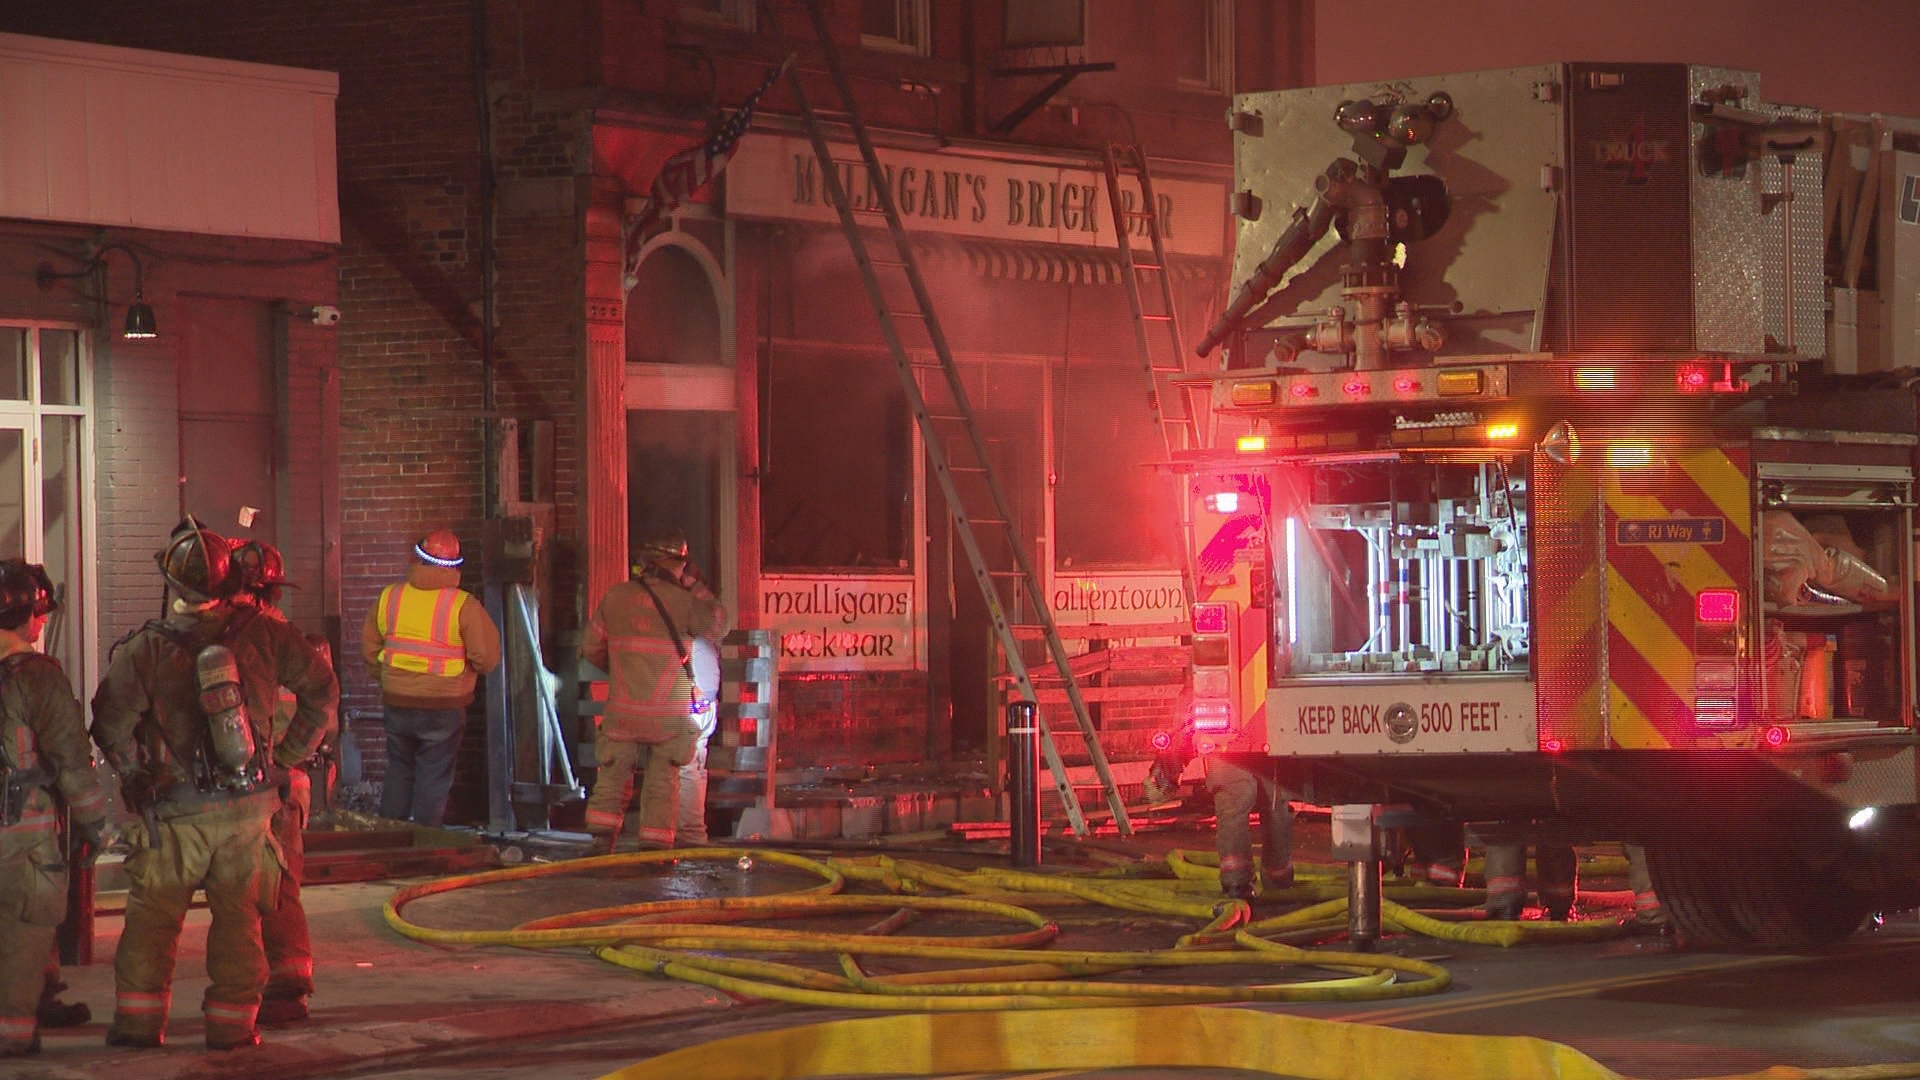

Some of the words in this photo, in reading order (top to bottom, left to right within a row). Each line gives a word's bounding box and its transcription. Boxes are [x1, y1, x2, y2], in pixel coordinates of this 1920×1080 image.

[1591, 141, 1670, 161] TRUCK
[1007, 178, 1099, 233] BRICK
[1648, 525, 1662, 540] RJ
[1667, 524, 1693, 541] Way
[764, 584, 908, 624] mulligans
[1055, 583, 1182, 611] allentown
[1298, 705, 1336, 735] KEEP
[1342, 704, 1381, 734] BACK
[1421, 702, 1452, 732] 500
[1460, 702, 1500, 731] FEET
